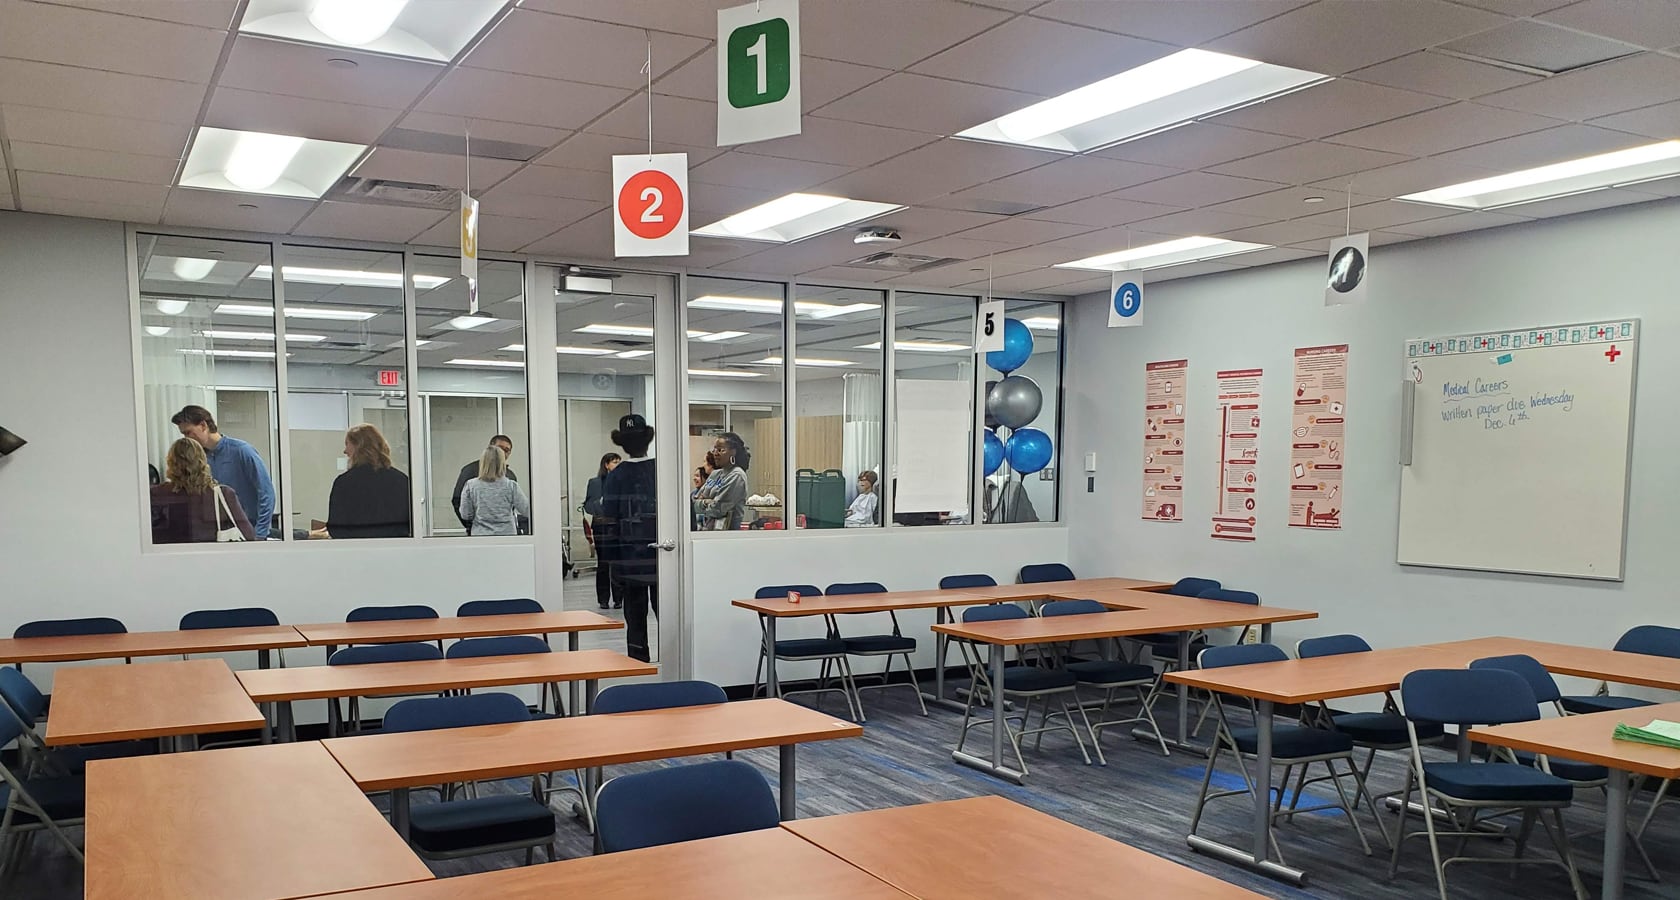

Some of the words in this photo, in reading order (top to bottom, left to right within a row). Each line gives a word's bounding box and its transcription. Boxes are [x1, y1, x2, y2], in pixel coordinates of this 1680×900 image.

[746, 33, 767, 95] 1
[640, 186, 664, 223] 2
[1122, 290, 1133, 310] 6
[984, 312, 994, 336] 5
[381, 371, 398, 385] EXIT
[1443, 380, 1470, 397] Medical
[1475, 377, 1509, 394] Careers
[1476, 403, 1504, 419] paper
[1506, 397, 1526, 411] due
[1530, 389, 1574, 412] Wednesday
